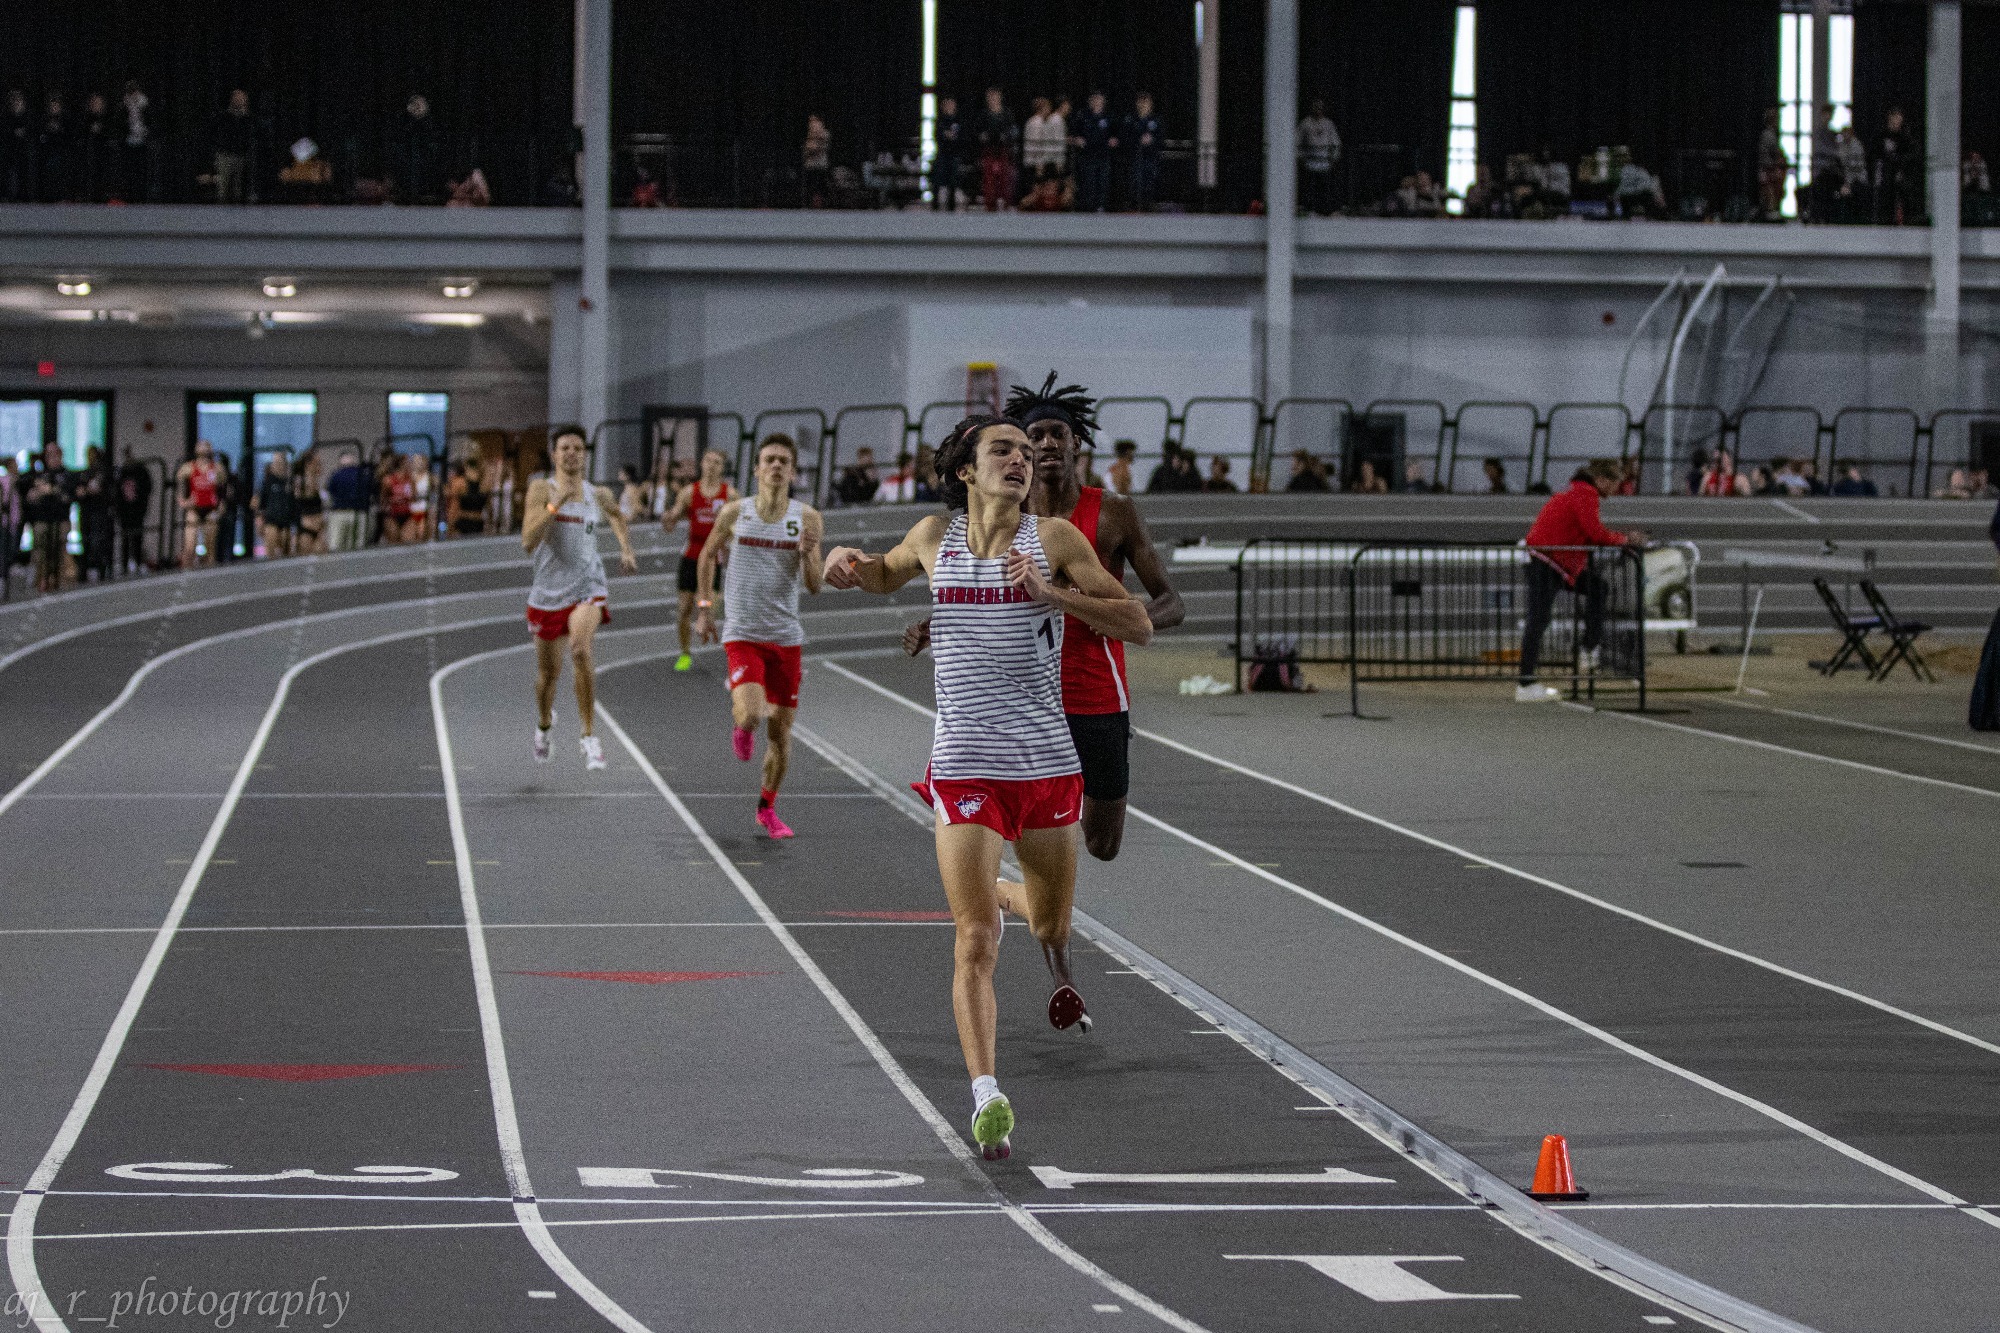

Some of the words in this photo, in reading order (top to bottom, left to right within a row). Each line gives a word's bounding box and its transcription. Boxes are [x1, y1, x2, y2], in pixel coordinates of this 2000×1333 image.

[786, 520, 799, 537] 5
[1037, 616, 1055, 651] 1
[104, 1161, 461, 1184] 3
[576, 1166, 926, 1189] 2
[1028, 1165, 1397, 1189] 1
